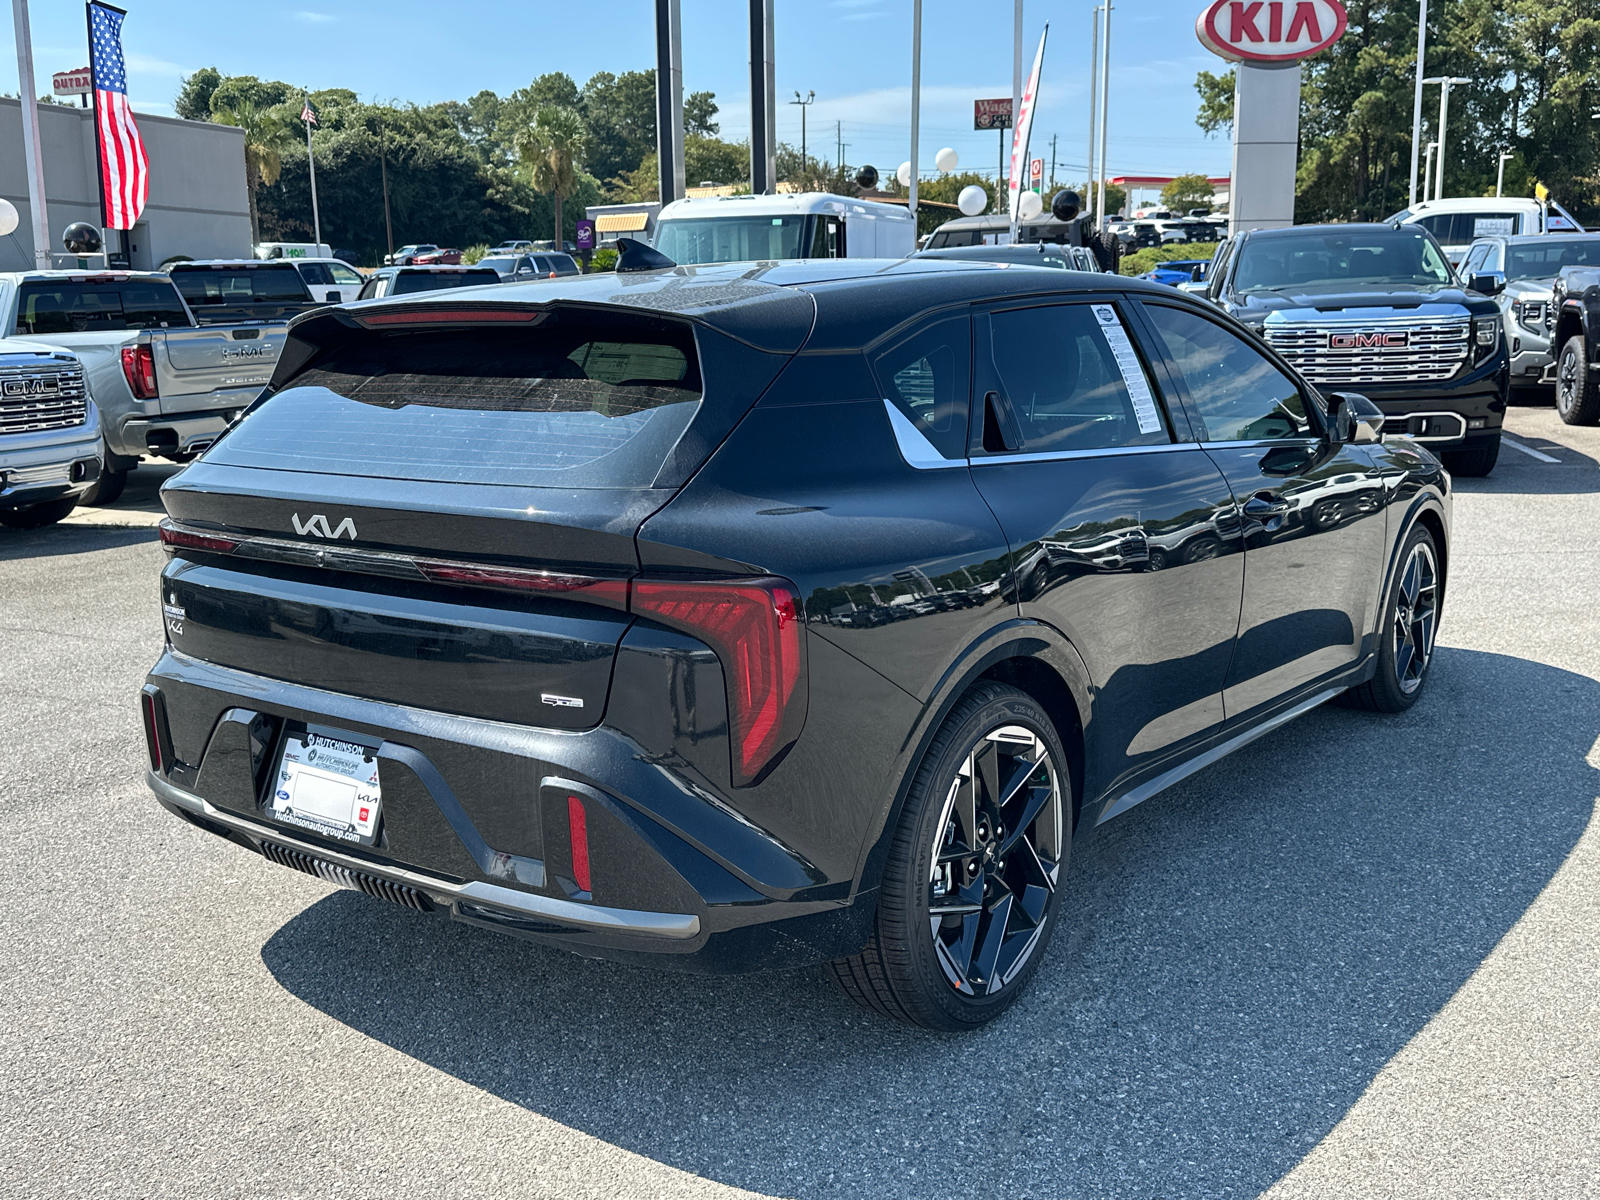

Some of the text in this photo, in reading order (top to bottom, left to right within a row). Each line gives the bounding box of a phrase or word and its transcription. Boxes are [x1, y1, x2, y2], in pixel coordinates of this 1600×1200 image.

[1229, 2, 1323, 43] KIA
[1332, 333, 1406, 348] GMC
[222, 344, 275, 360] GMC
[4, 379, 58, 396] GMC
[291, 512, 358, 541] KIA
[168, 619, 183, 635] K4
[315, 736, 365, 756] HUTCHINSON
